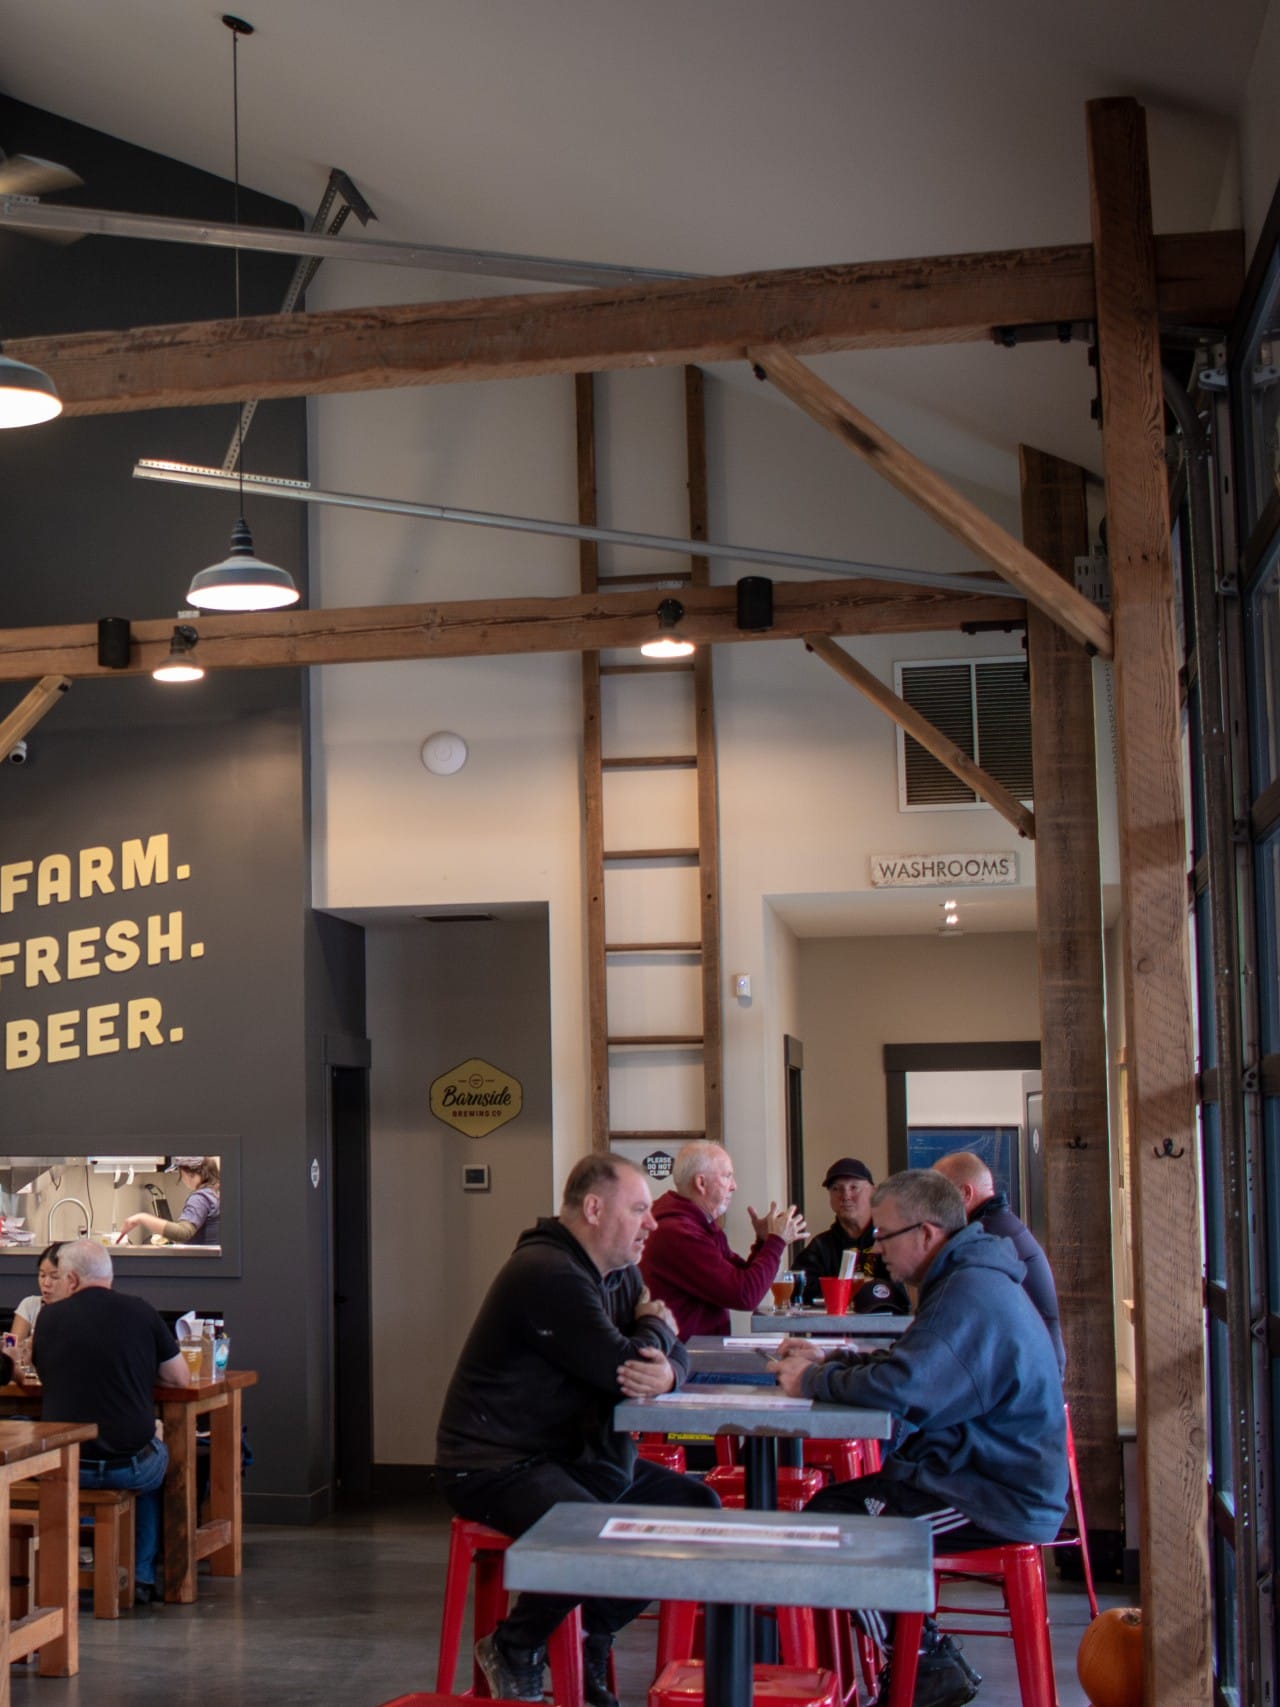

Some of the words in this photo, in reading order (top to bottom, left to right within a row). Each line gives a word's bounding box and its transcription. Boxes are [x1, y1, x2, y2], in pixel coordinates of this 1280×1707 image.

[0, 833, 191, 913] FARM.
[879, 859, 1009, 879] WASHROOMS
[6, 998, 184, 1070] BEER.
[442, 1085, 512, 1107] Barnside
[452, 1110, 490, 1118] BREWING
